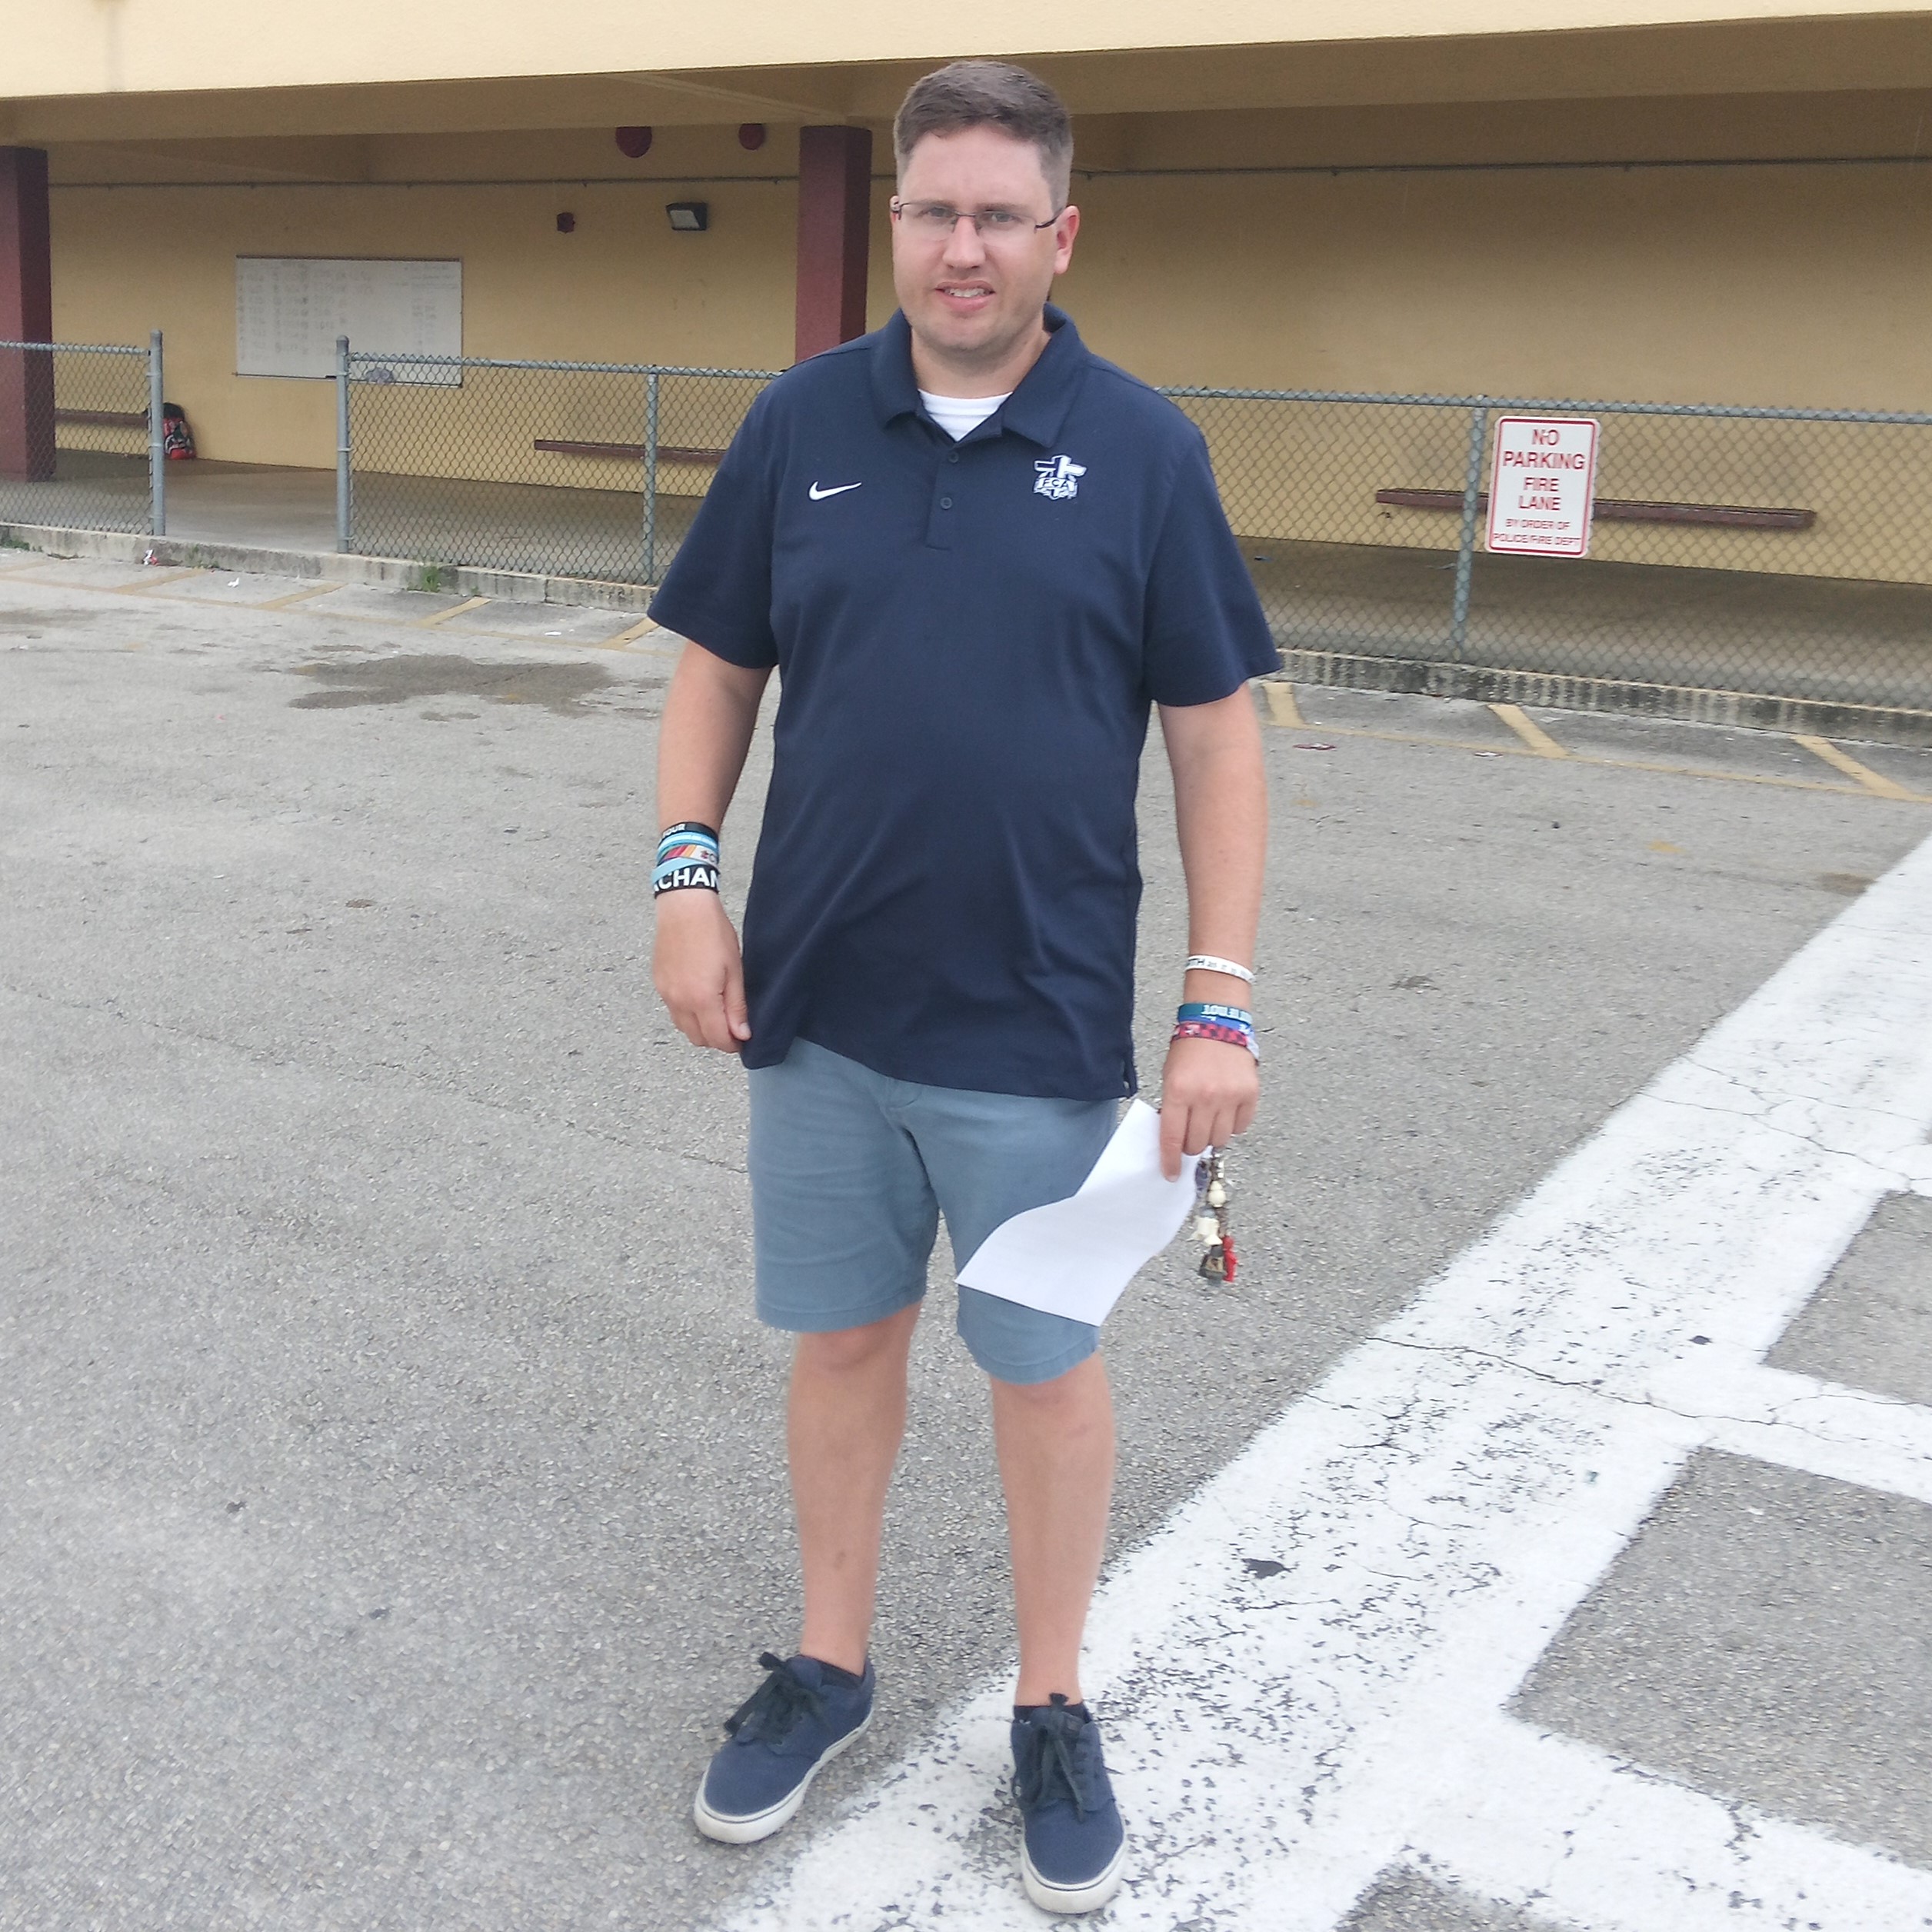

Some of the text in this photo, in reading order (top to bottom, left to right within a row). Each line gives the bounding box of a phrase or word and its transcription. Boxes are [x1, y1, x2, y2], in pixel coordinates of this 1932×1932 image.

[1531, 428, 1561, 446] NO
[1502, 451, 1586, 470] PARKING
[1523, 476, 1560, 491] FIRE
[1517, 495, 1561, 511] LANE
[1505, 518, 1571, 530] BY ORDER OF
